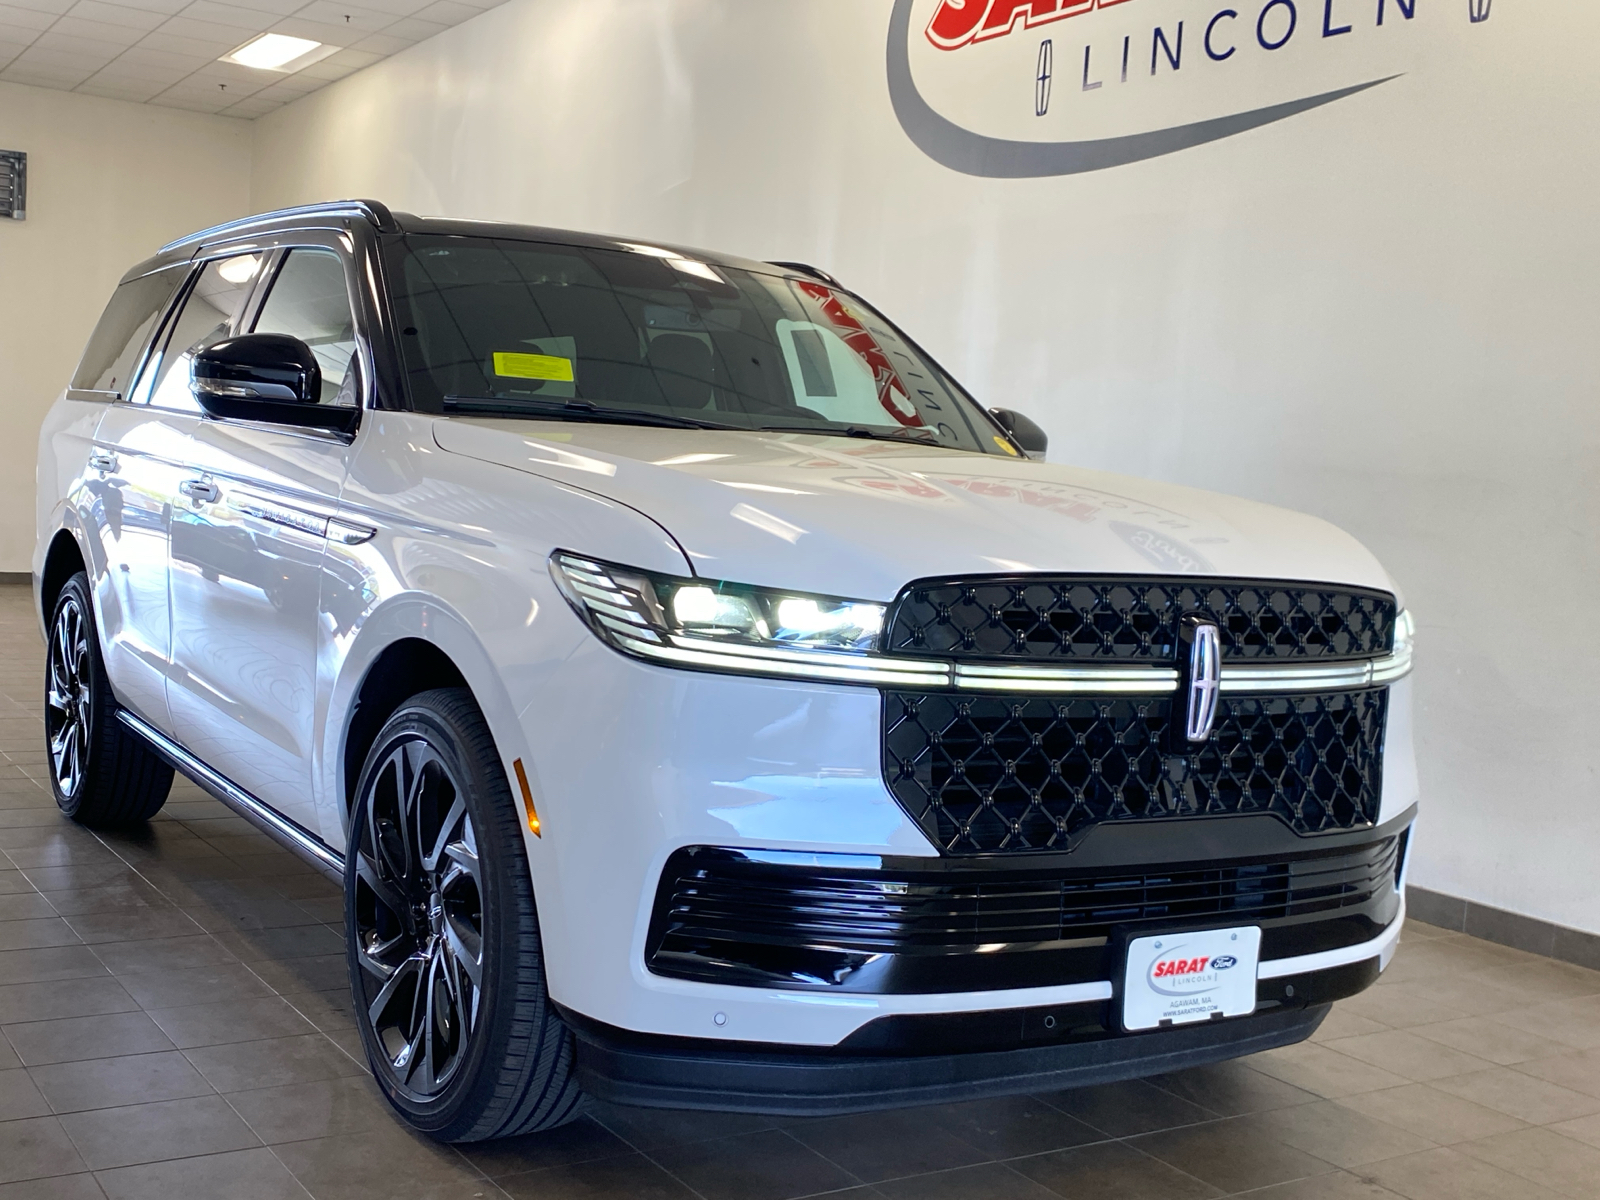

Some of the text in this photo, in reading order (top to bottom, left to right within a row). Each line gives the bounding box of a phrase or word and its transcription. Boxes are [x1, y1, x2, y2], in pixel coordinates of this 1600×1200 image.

[1153, 955, 1235, 978] SARAT Ford
[1177, 975, 1212, 985] LINCOLN
[1201, 996, 1212, 1004] MA
[1162, 1005, 1218, 1017] WWW.SARATFORD.COM
